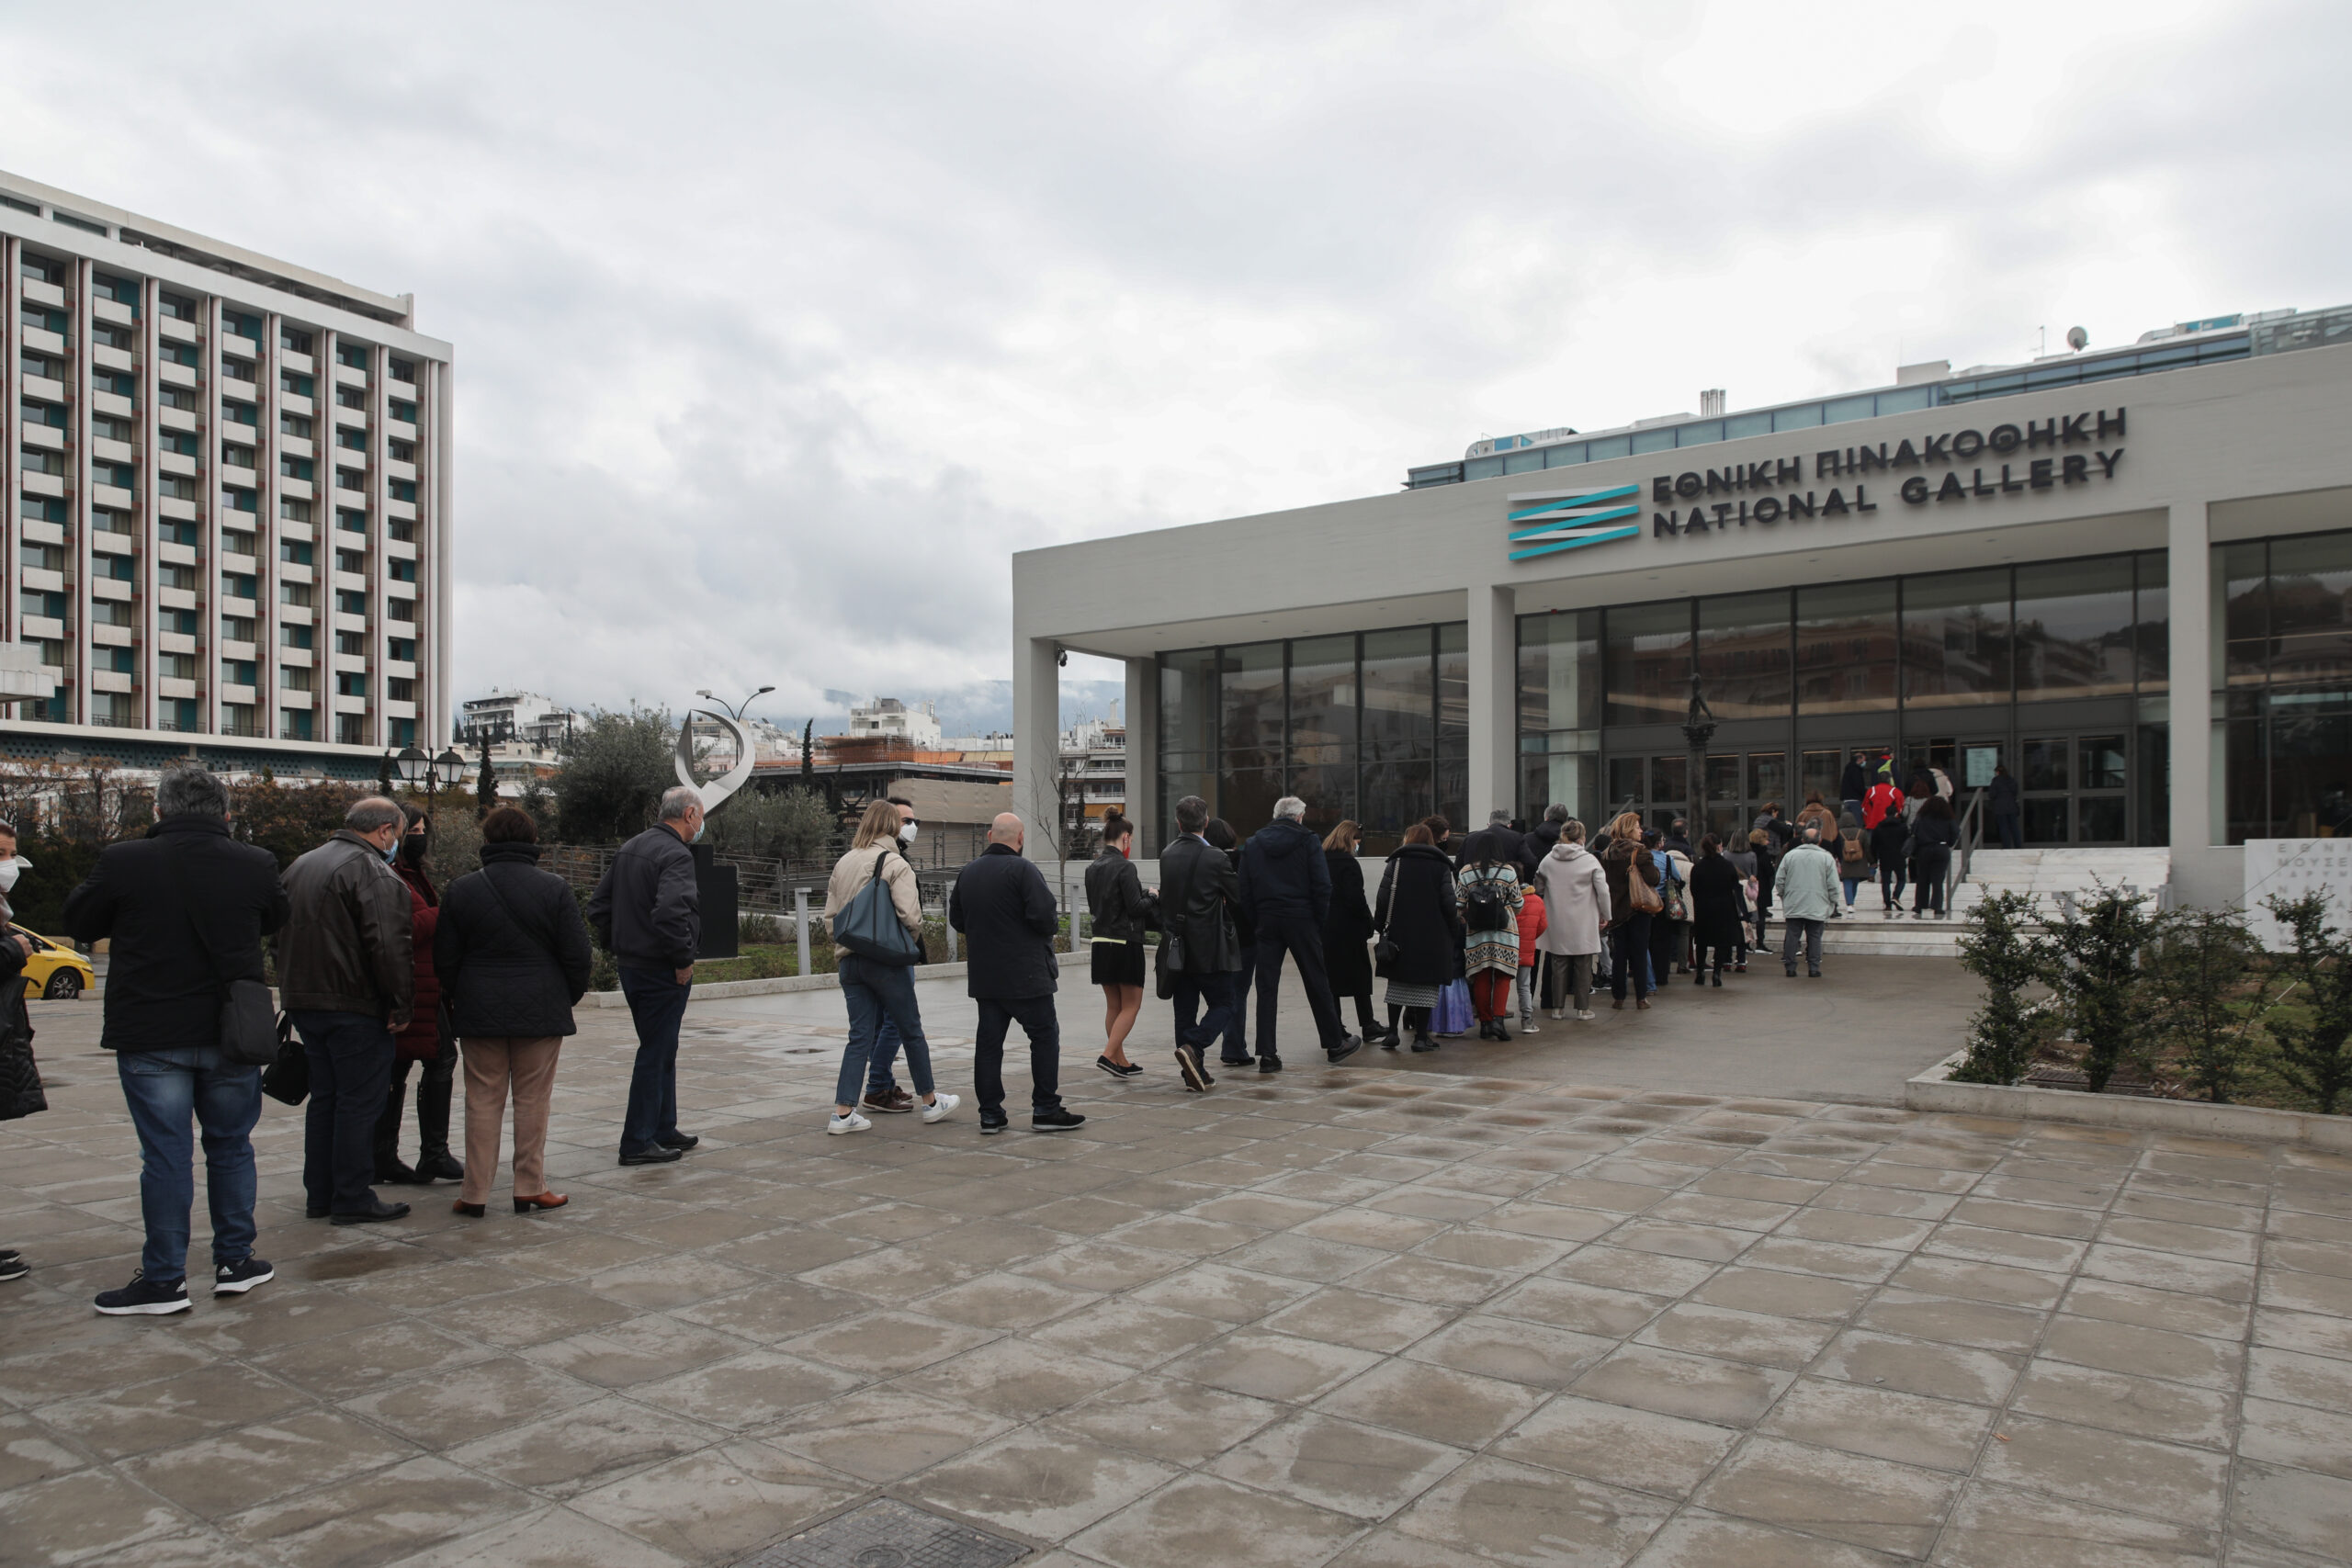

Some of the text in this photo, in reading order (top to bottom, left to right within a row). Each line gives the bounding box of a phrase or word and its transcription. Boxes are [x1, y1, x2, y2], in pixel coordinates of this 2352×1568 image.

[1653, 407, 2126, 502] ΕΘΝΙΚΗ ΠΙΝΑΚΟΘΗΚΗ
[1654, 448, 2125, 537] NATIONAL GALLERY
